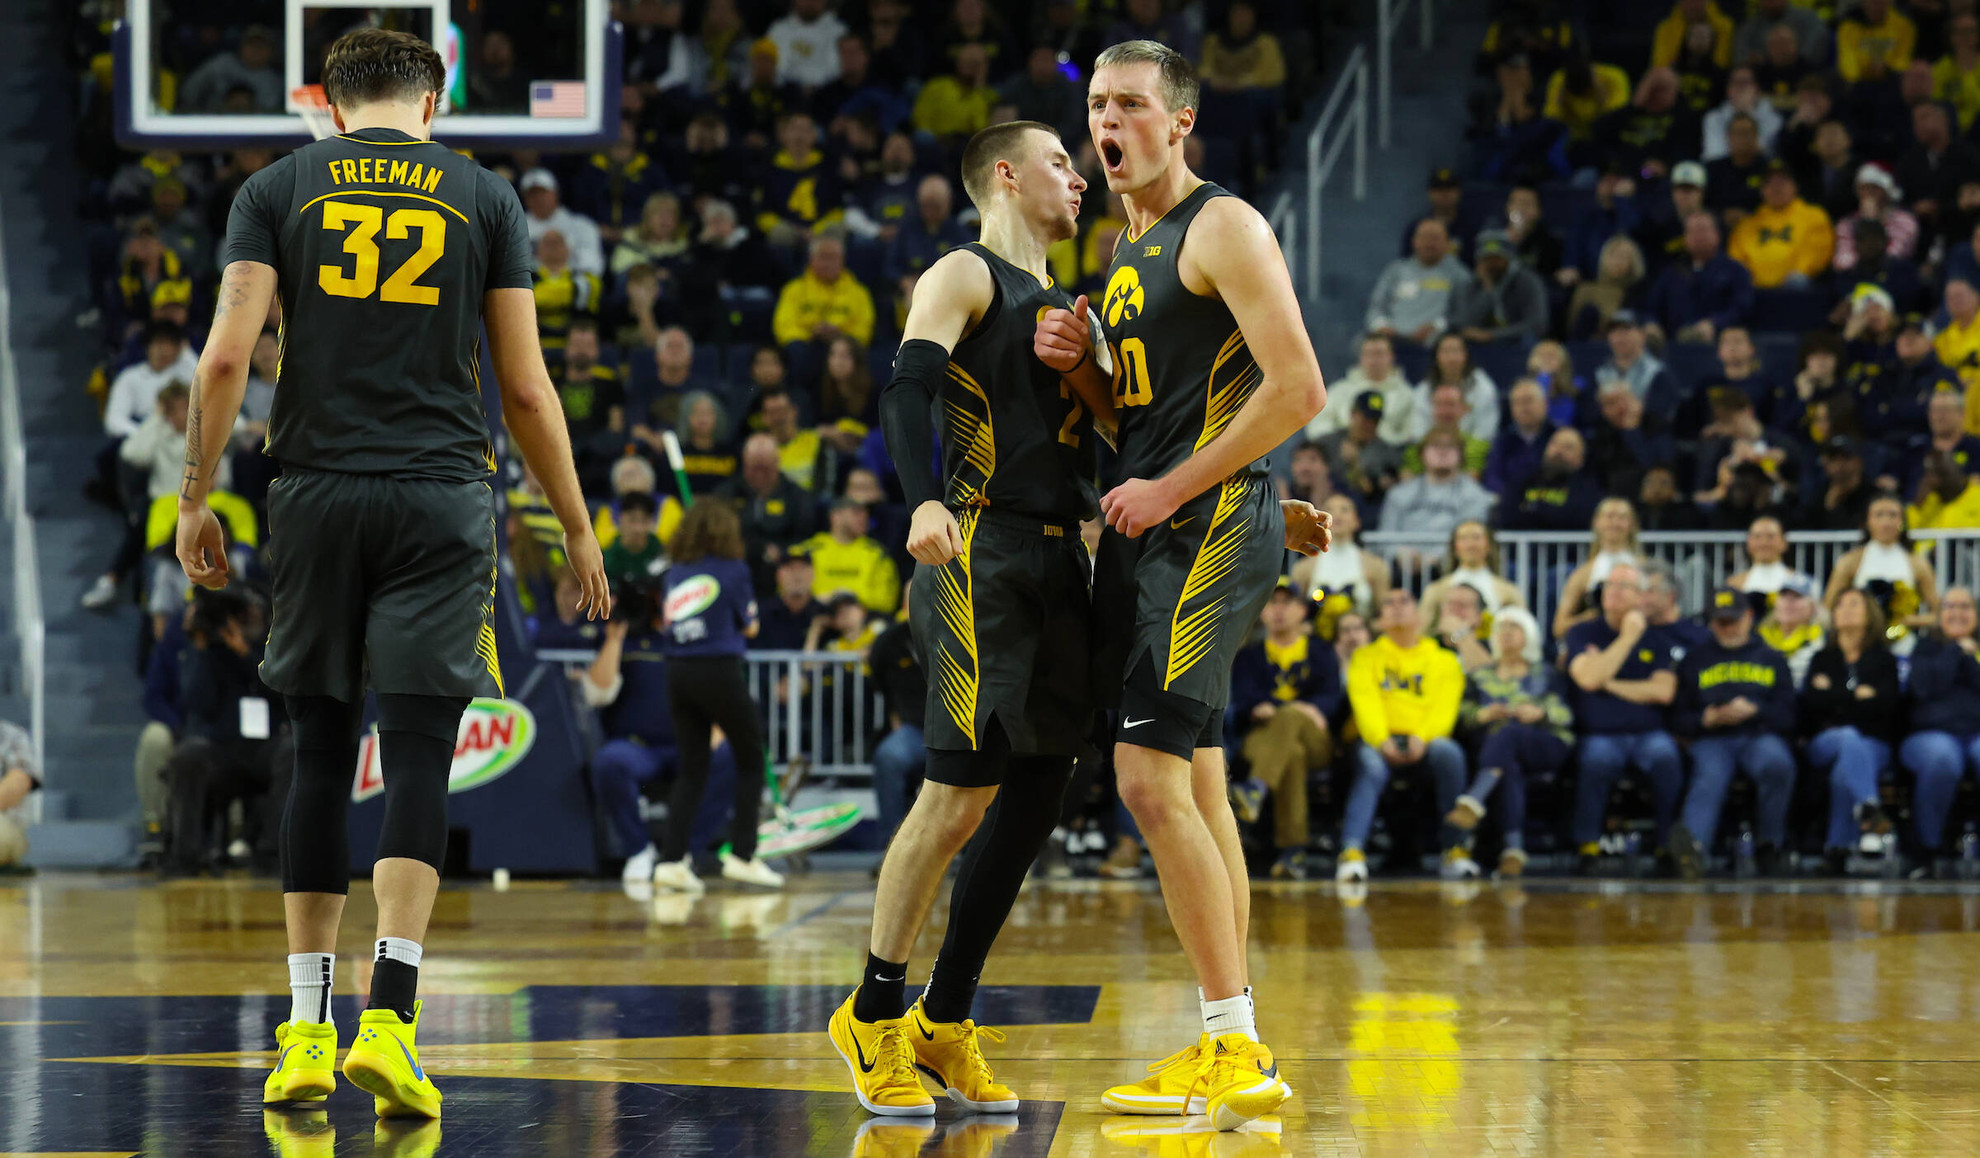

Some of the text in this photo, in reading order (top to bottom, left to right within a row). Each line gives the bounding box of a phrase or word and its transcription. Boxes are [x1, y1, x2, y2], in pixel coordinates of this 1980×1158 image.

[328, 158, 444, 194] FREEMAN
[318, 201, 447, 306] 32
[360, 712, 514, 791] LAN
